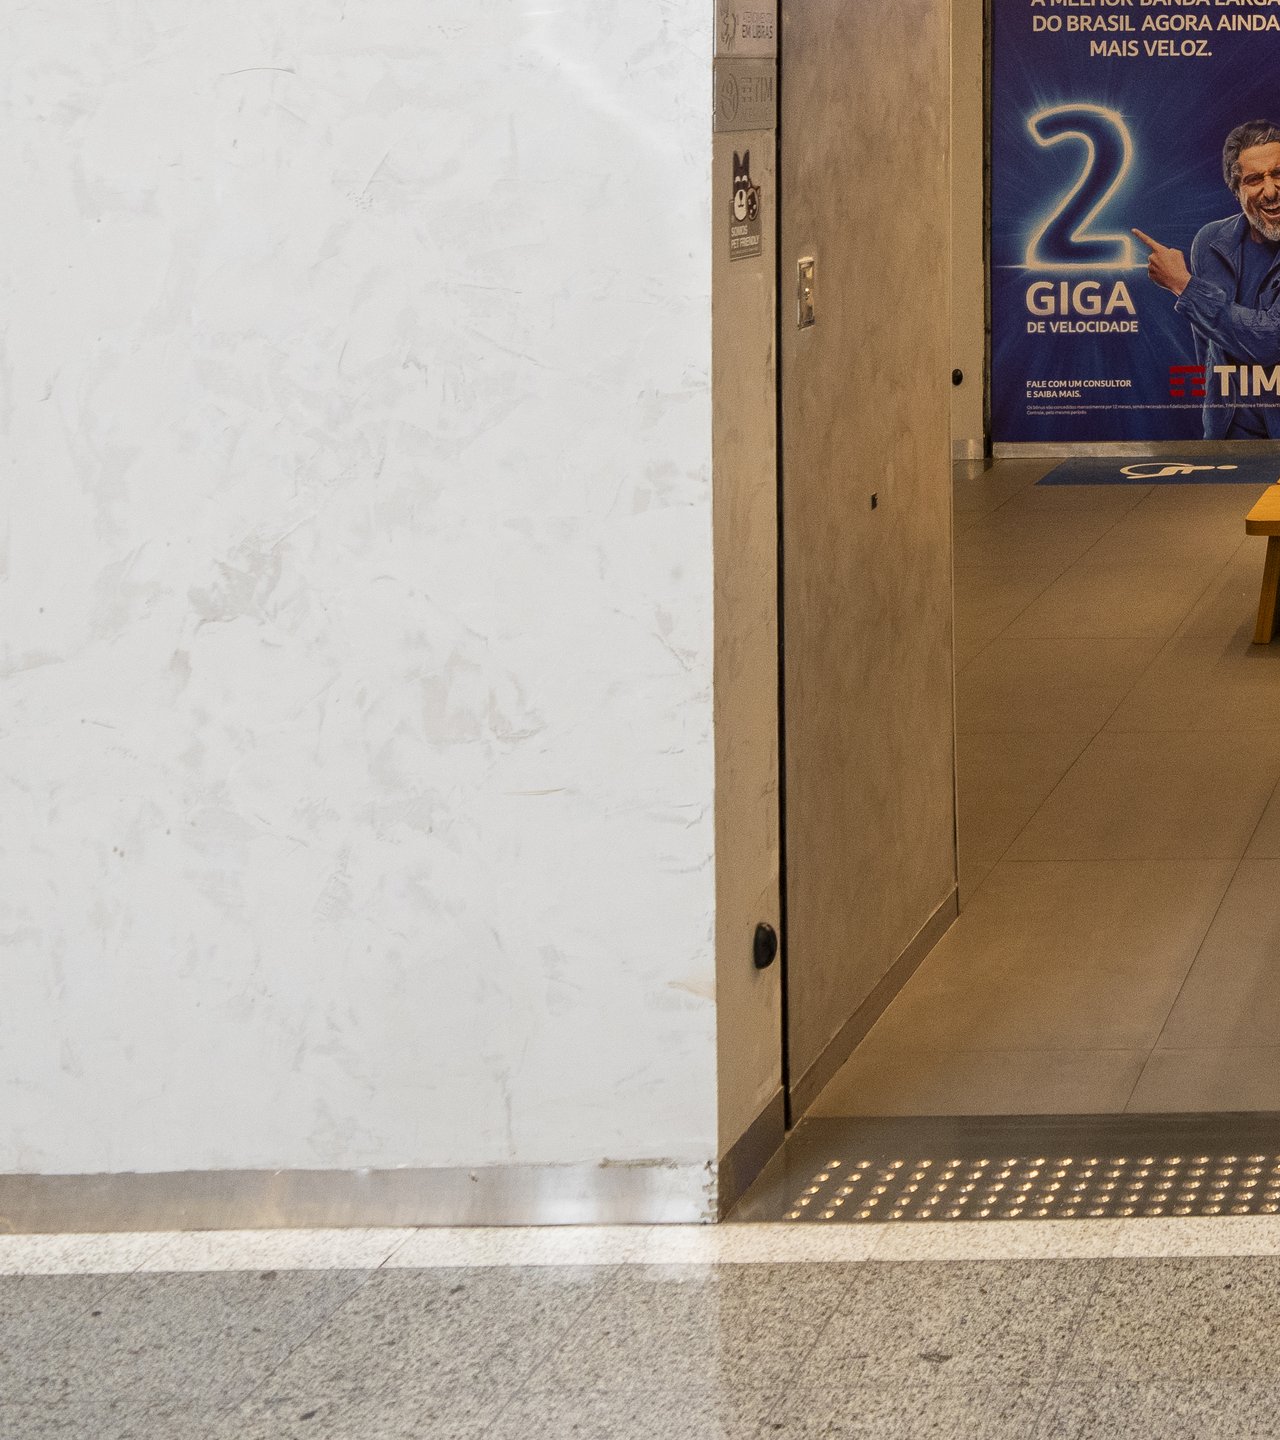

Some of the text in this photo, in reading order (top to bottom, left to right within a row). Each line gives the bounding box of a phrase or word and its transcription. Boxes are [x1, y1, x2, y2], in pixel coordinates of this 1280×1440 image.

[1033, 15, 1280, 31] DO BRASIL AGORA AINDA
[753, 25, 773, 39] LIBRAS
[1091, 40, 1212, 56] MAIS VELOZ.
[1027, 103, 1133, 270] 2
[1025, 280, 1137, 316] GIGA
[1028, 321, 1138, 333] DE VELOCIDADE
